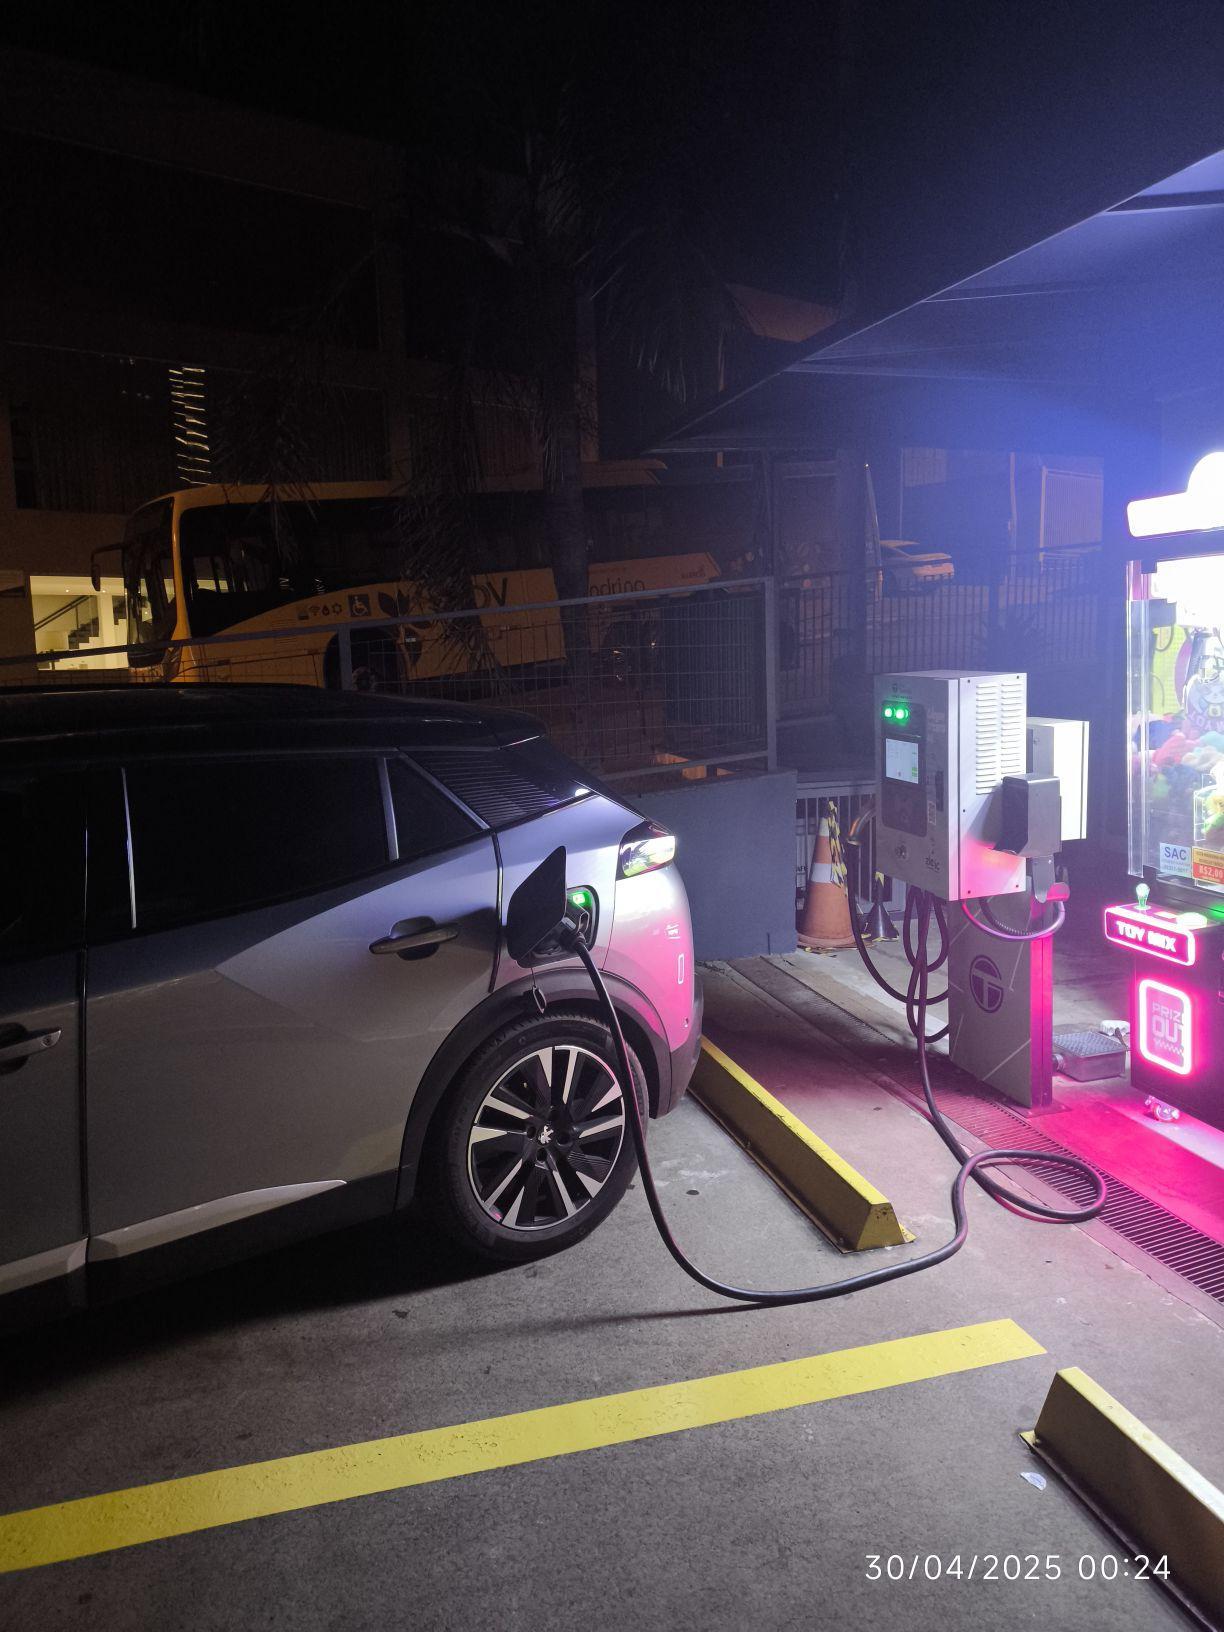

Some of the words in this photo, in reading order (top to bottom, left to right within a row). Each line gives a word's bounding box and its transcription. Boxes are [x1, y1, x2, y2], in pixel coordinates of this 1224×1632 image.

[1164, 846, 1187, 861] SAC
[1116, 920, 1146, 941] TOY
[1147, 930, 1177, 953] MIX
[1152, 1001, 1182, 1024] PRIZ
